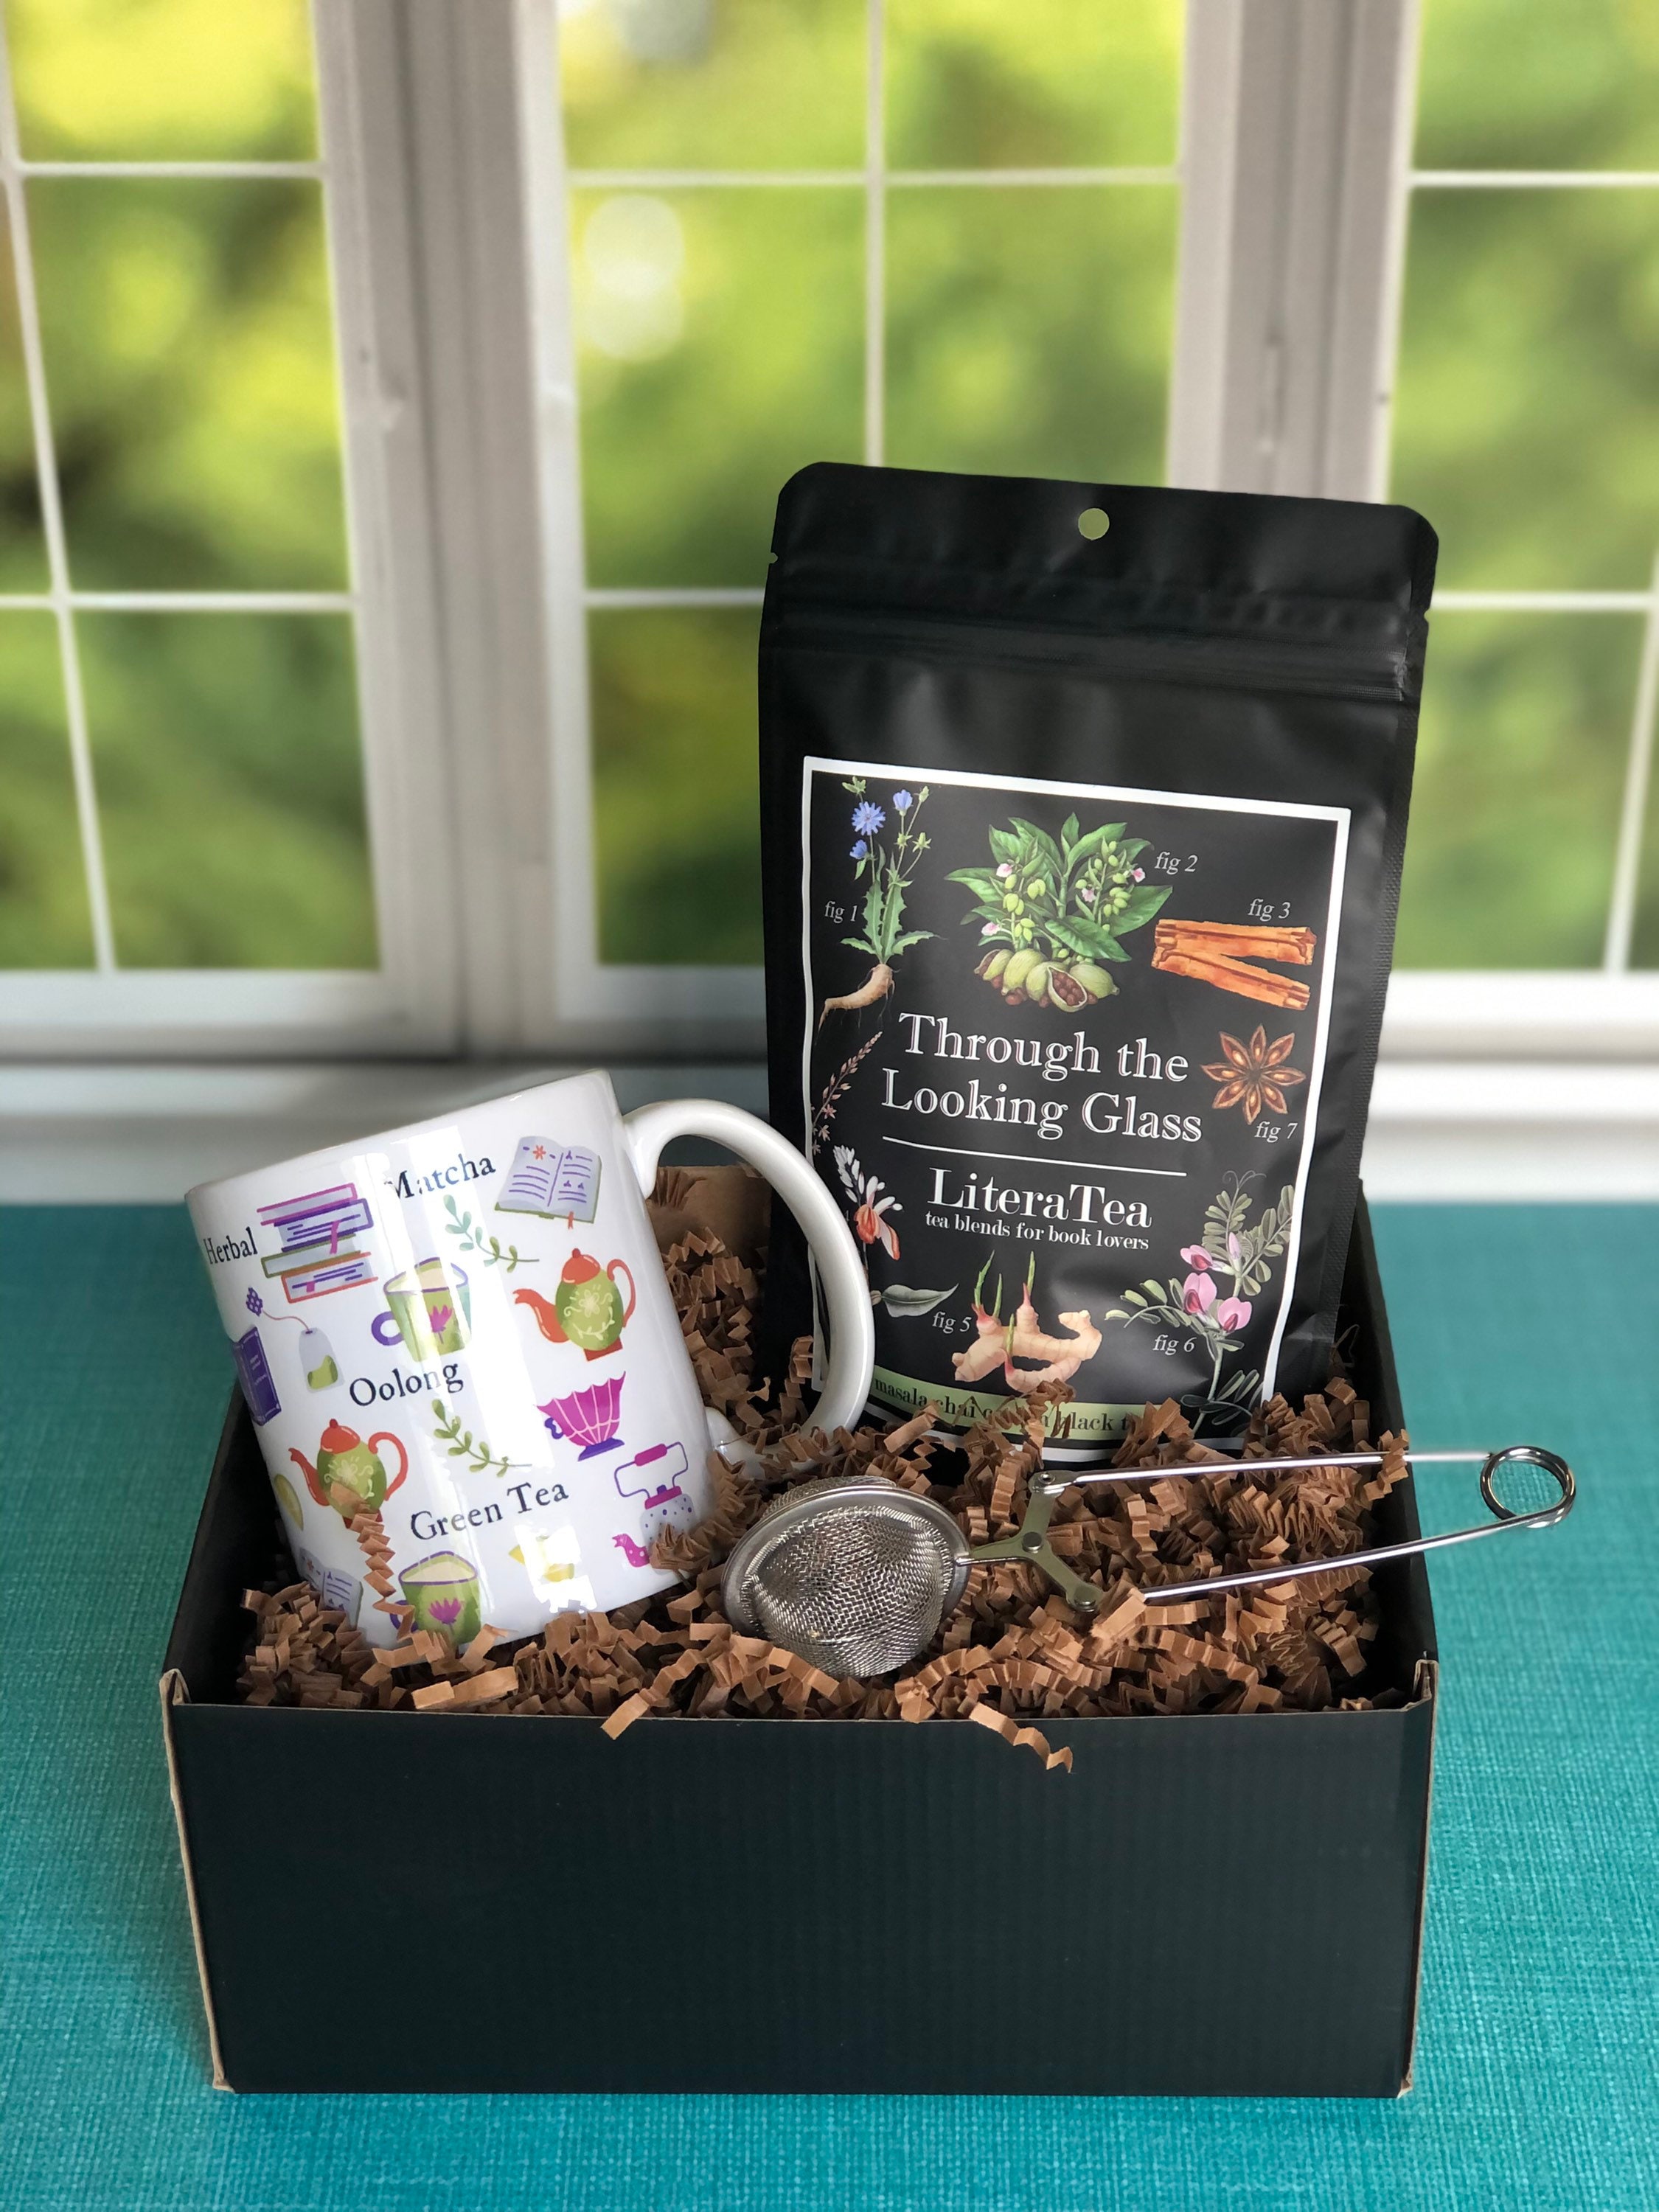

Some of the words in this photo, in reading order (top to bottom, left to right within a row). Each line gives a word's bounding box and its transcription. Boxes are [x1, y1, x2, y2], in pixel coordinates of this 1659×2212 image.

[1155, 852, 1181, 875] fig
[1184, 855, 1198, 872] 2
[824, 900, 845, 924] fig
[850, 905, 858, 922] 1
[1248, 898, 1275, 922] fig
[1278, 902, 1291, 919] 3
[898, 1012, 1102, 1082] Through
[1117, 1037, 1189, 1082] the
[881, 1068, 1068, 1140] Looking
[1082, 1091, 1202, 1142] Glass
[1254, 1121, 1281, 1143] fig
[1287, 1122, 1298, 1139] 7
[927, 1167, 1152, 1228] LiteraTea
[203, 1225, 258, 1265] Herbal
[925, 1210, 950, 1229] tea
[954, 1214, 1011, 1237] blends
[1015, 1222, 1044, 1241] for
[1048, 1225, 1091, 1246] book
[1096, 1230, 1150, 1251] lovers
[932, 1311, 956, 1334] fig
[959, 1316, 973, 1332] 5
[1152, 1334, 1179, 1355] fig
[1183, 1337, 1197, 1352] 6
[349, 1363, 464, 1407] Oolong
[874, 1377, 928, 1407] masala
[411, 1503, 503, 1540] Green
[507, 1481, 569, 1514] Tea
